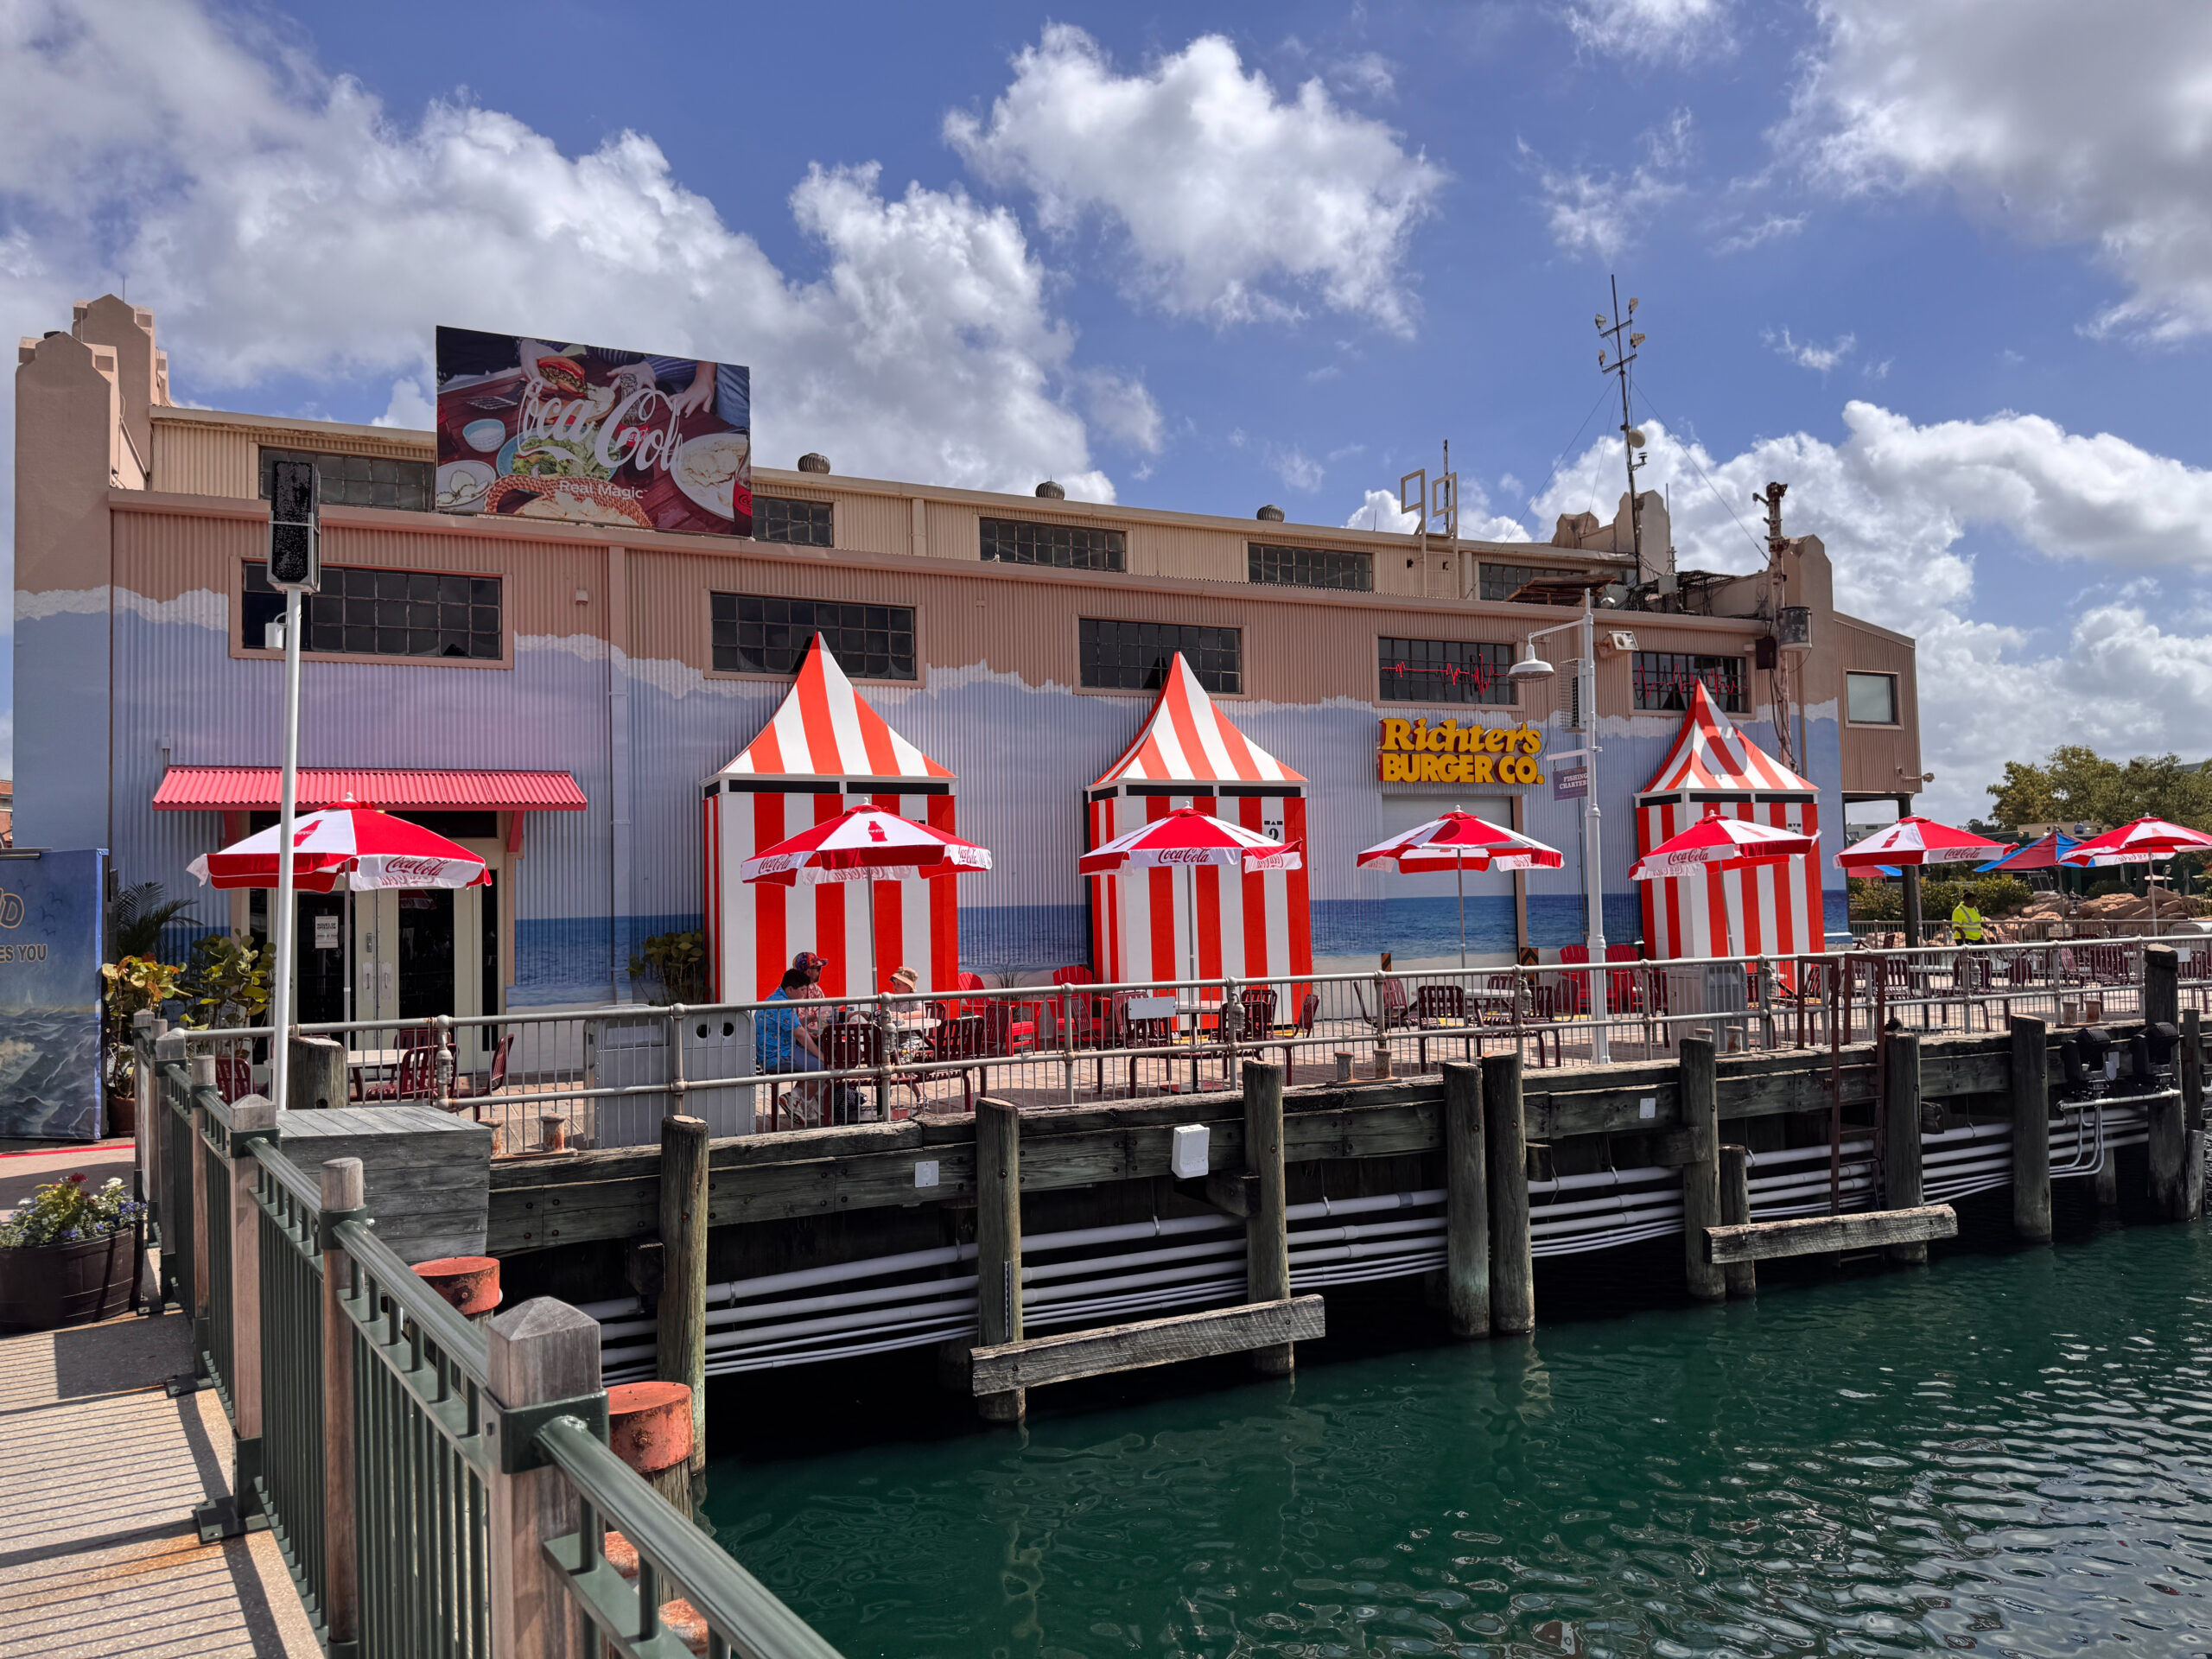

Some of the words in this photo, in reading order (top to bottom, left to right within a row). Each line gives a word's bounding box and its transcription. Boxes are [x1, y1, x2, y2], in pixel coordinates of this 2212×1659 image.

[559, 480, 594, 494] Real
[598, 484, 644, 499] Magic
[1380, 717, 1541, 754] Richter's
[1381, 753, 1495, 784] BURGER
[1497, 754, 1545, 785] CO.
[17, 944, 48, 963] YOU
